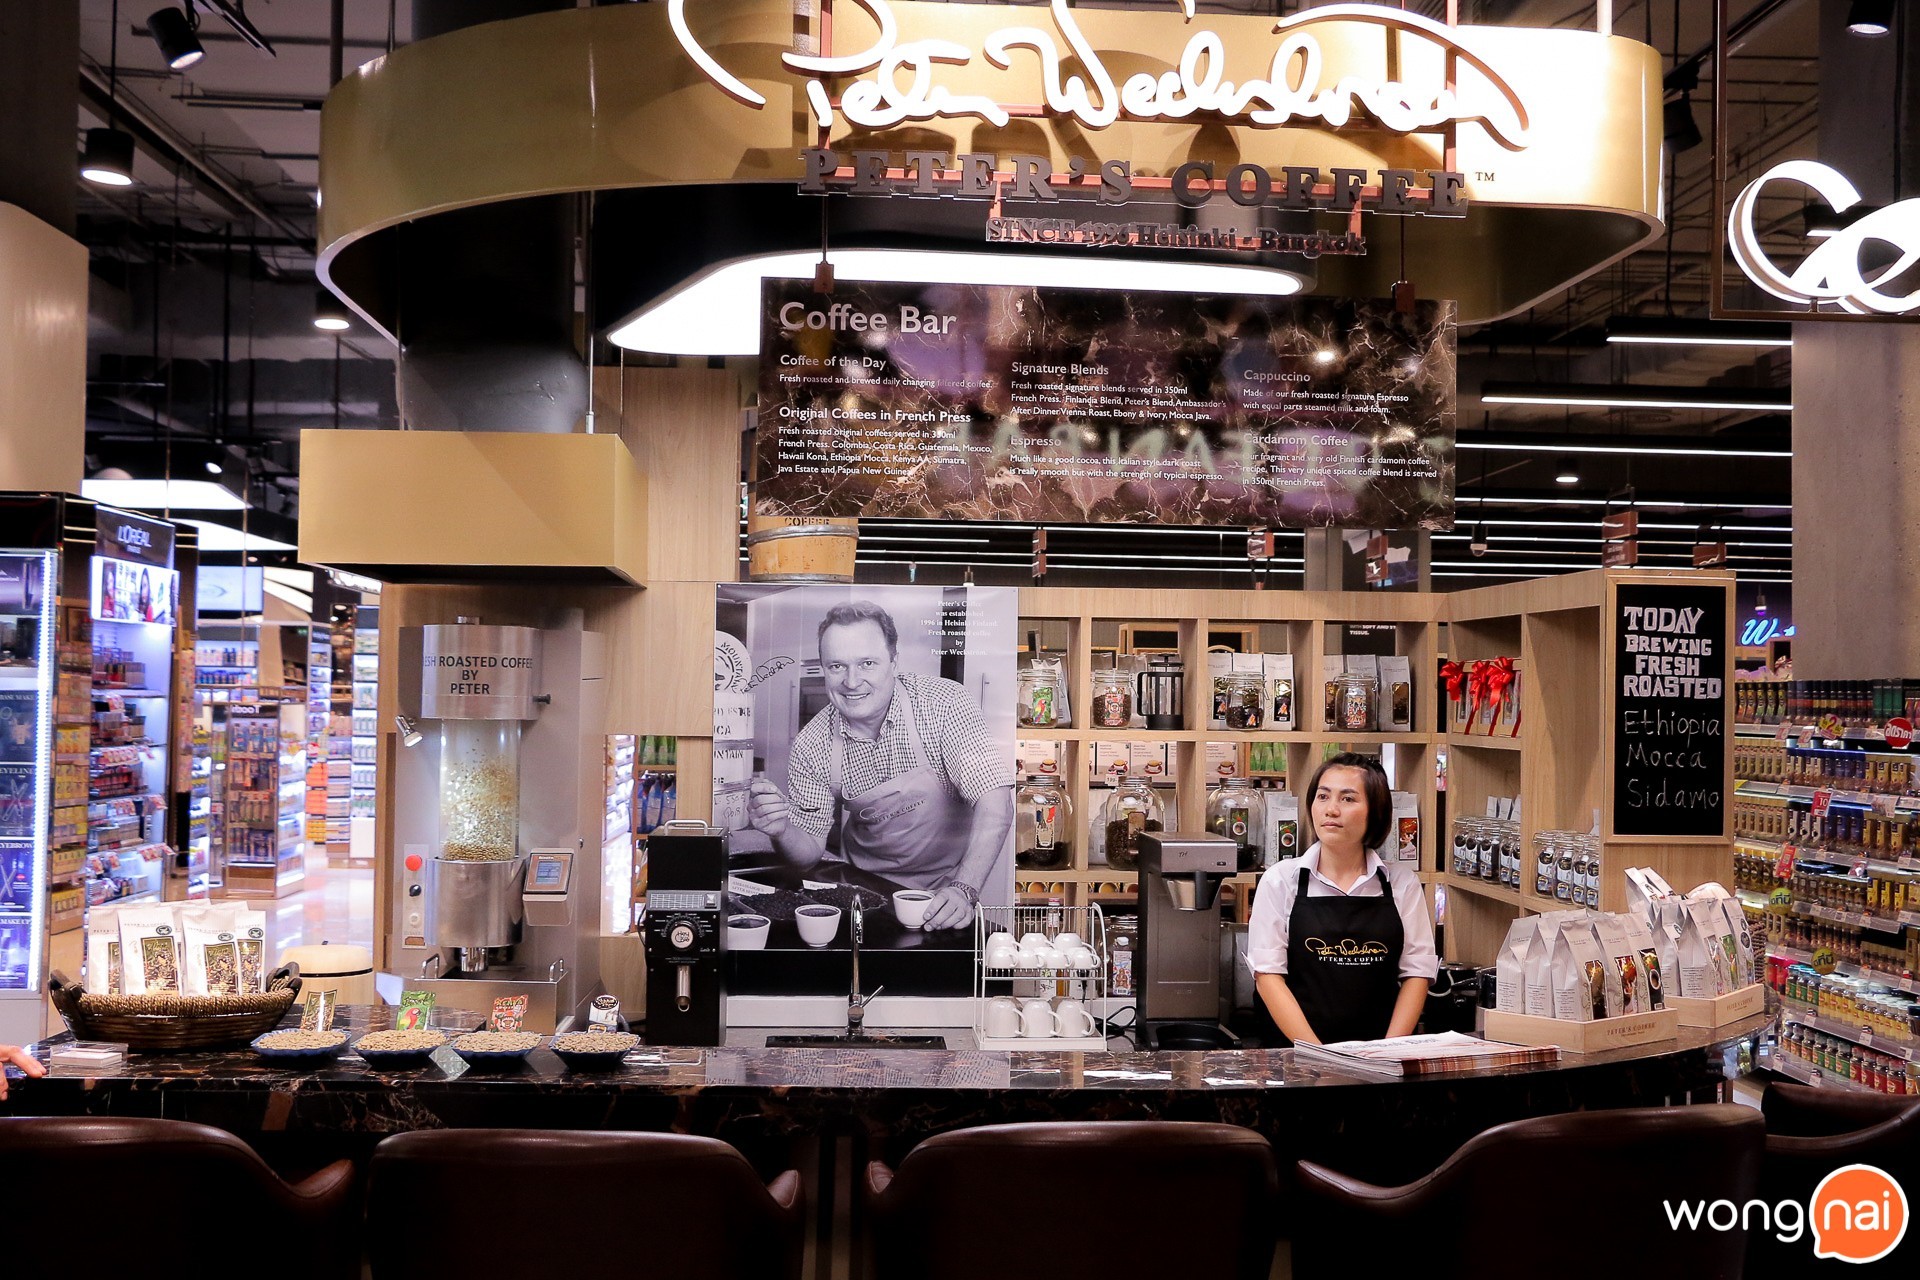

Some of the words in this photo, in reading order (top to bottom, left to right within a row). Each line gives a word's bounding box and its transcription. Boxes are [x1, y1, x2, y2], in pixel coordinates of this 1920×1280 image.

[801, 149, 1132, 204] PETER'S
[1171, 160, 1466, 212] COFFEE
[987, 217, 1075, 242] SINCE
[1081, 221, 1130, 245] 1996
[1137, 224, 1237, 249] Helsinki
[1260, 229, 1366, 257] Bangkok
[779, 301, 888, 332] Coffee
[900, 305, 957, 335] Bar
[780, 354, 820, 366] Coffee
[823, 355, 837, 366] of
[839, 356, 859, 367] the
[862, 357, 886, 371] Day
[1011, 362, 1067, 376] Signature
[1070, 363, 1109, 375] Blends
[779, 374, 800, 383] Fresh
[803, 374, 833, 383] roasted
[835, 375, 850, 384] and
[851, 376, 880, 385] brewed
[882, 377, 900, 388] daily
[902, 377, 935, 389] changing
[1243, 369, 1311, 384] Cappuccino
[1011, 381, 1032, 390] Fresh
[1034, 382, 1063, 391] roasted
[1065, 383, 1099, 394] signature
[1101, 384, 1126, 392] blends
[1155, 385, 1163, 393] in
[1164, 385, 1188, 394] 350ml
[1011, 394, 1037, 402] French
[1065, 395, 1098, 404] Finlandia
[1100, 396, 1123, 406] Blend,
[1124, 397, 1150, 405] Peter's
[1175, 398, 1227, 408] Ambassador's
[1291, 390, 1310, 398] fresh
[1311, 391, 1340, 399] roasted
[1376, 393, 1409, 404] Espresso
[1243, 401, 1259, 409] with
[1261, 402, 1282, 412] equal
[1283, 402, 1303, 413] parts
[1304, 403, 1336, 411] steamed
[779, 407, 828, 421] Original
[831, 408, 877, 420] Coffees
[880, 409, 891, 420] in
[895, 410, 935, 421] French
[939, 411, 971, 422] Press
[1088, 408, 1112, 418] Roast,
[1113, 409, 1137, 420] Ebony
[1138, 410, 1145, 418] &
[1169, 411, 1193, 419] Mocca
[778, 427, 800, 435] Fresh
[802, 427, 832, 436] roasted
[834, 428, 863, 439] original
[894, 429, 920, 438] served
[1243, 433, 1307, 445] Cardamom
[1310, 435, 1348, 446] Coffee
[778, 439, 805, 448] French
[873, 442, 895, 450] Costa
[1010, 436, 1062, 449] Espresso
[778, 452, 805, 461] Hawaii
[806, 453, 829, 462] Kona,
[830, 453, 861, 464] Ethiopia
[892, 455, 916, 465] Kenya
[1009, 455, 1031, 463] Much
[1033, 455, 1047, 463] like
[1054, 456, 1075, 466] good
[1260, 453, 1290, 464] fragrant
[1325, 455, 1337, 463] old
[1367, 455, 1406, 464] cardamom
[1407, 456, 1430, 465] coffee
[777, 465, 792, 475] Java
[794, 465, 819, 474] Estate
[821, 465, 835, 474] and
[837, 466, 860, 476] Papua
[862, 466, 881, 474] New
[1040, 468, 1070, 476] smooth
[1072, 468, 1084, 477] but
[1086, 469, 1103, 477] with
[1105, 469, 1118, 477] the
[1120, 470, 1150, 481] strength
[1154, 470, 1162, 479] of
[1163, 471, 1188, 481] typical
[1270, 465, 1286, 473] This
[1287, 468, 1304, 476] very
[1306, 466, 1331, 477] unique
[1333, 467, 1356, 478] spiced
[1358, 468, 1381, 476] coffee
[1382, 468, 1403, 477] blend
[1405, 469, 1411, 477] is
[1412, 469, 1437, 478] served
[1251, 477, 1275, 485] 350ml
[1277, 478, 1302, 486] French
[1623, 606, 1705, 635] TODAY
[1625, 634, 1713, 657] BREWING
[439, 656, 498, 668] ROASTED
[501, 657, 533, 669] COFFEE
[1635, 654, 1701, 677] FRESH
[462, 669, 479, 681] BY
[450, 683, 490, 695] PETER
[1623, 675, 1722, 700] ROASTED
[1624, 709, 1721, 749] Ethiopia
[1625, 743, 1707, 769] Mocca
[1627, 777, 1720, 810] Sidamo
